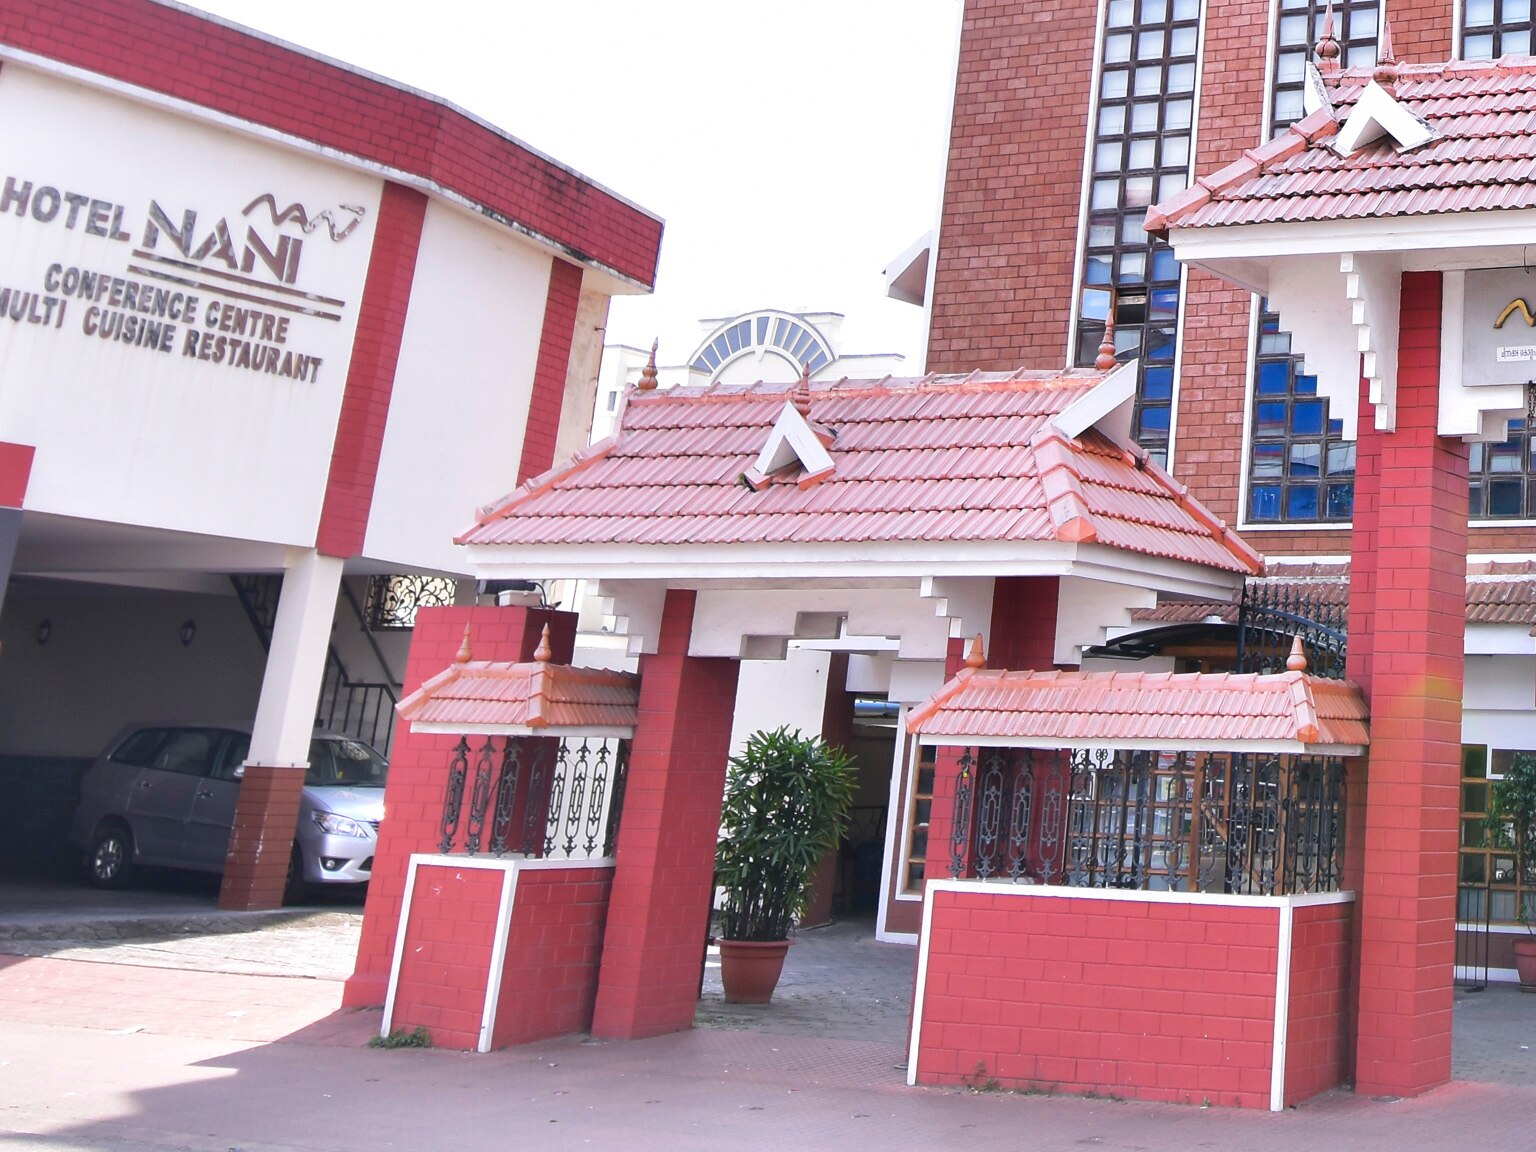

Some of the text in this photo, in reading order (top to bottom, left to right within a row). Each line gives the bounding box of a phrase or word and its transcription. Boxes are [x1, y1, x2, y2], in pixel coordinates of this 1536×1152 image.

[0, 176, 131, 243] HOTEL
[142, 199, 303, 285] NANI
[44, 263, 290, 343] CONFERENCE CENTRE
[82, 307, 176, 353] CUISINE
[181, 330, 323, 384] RESTAURANT
